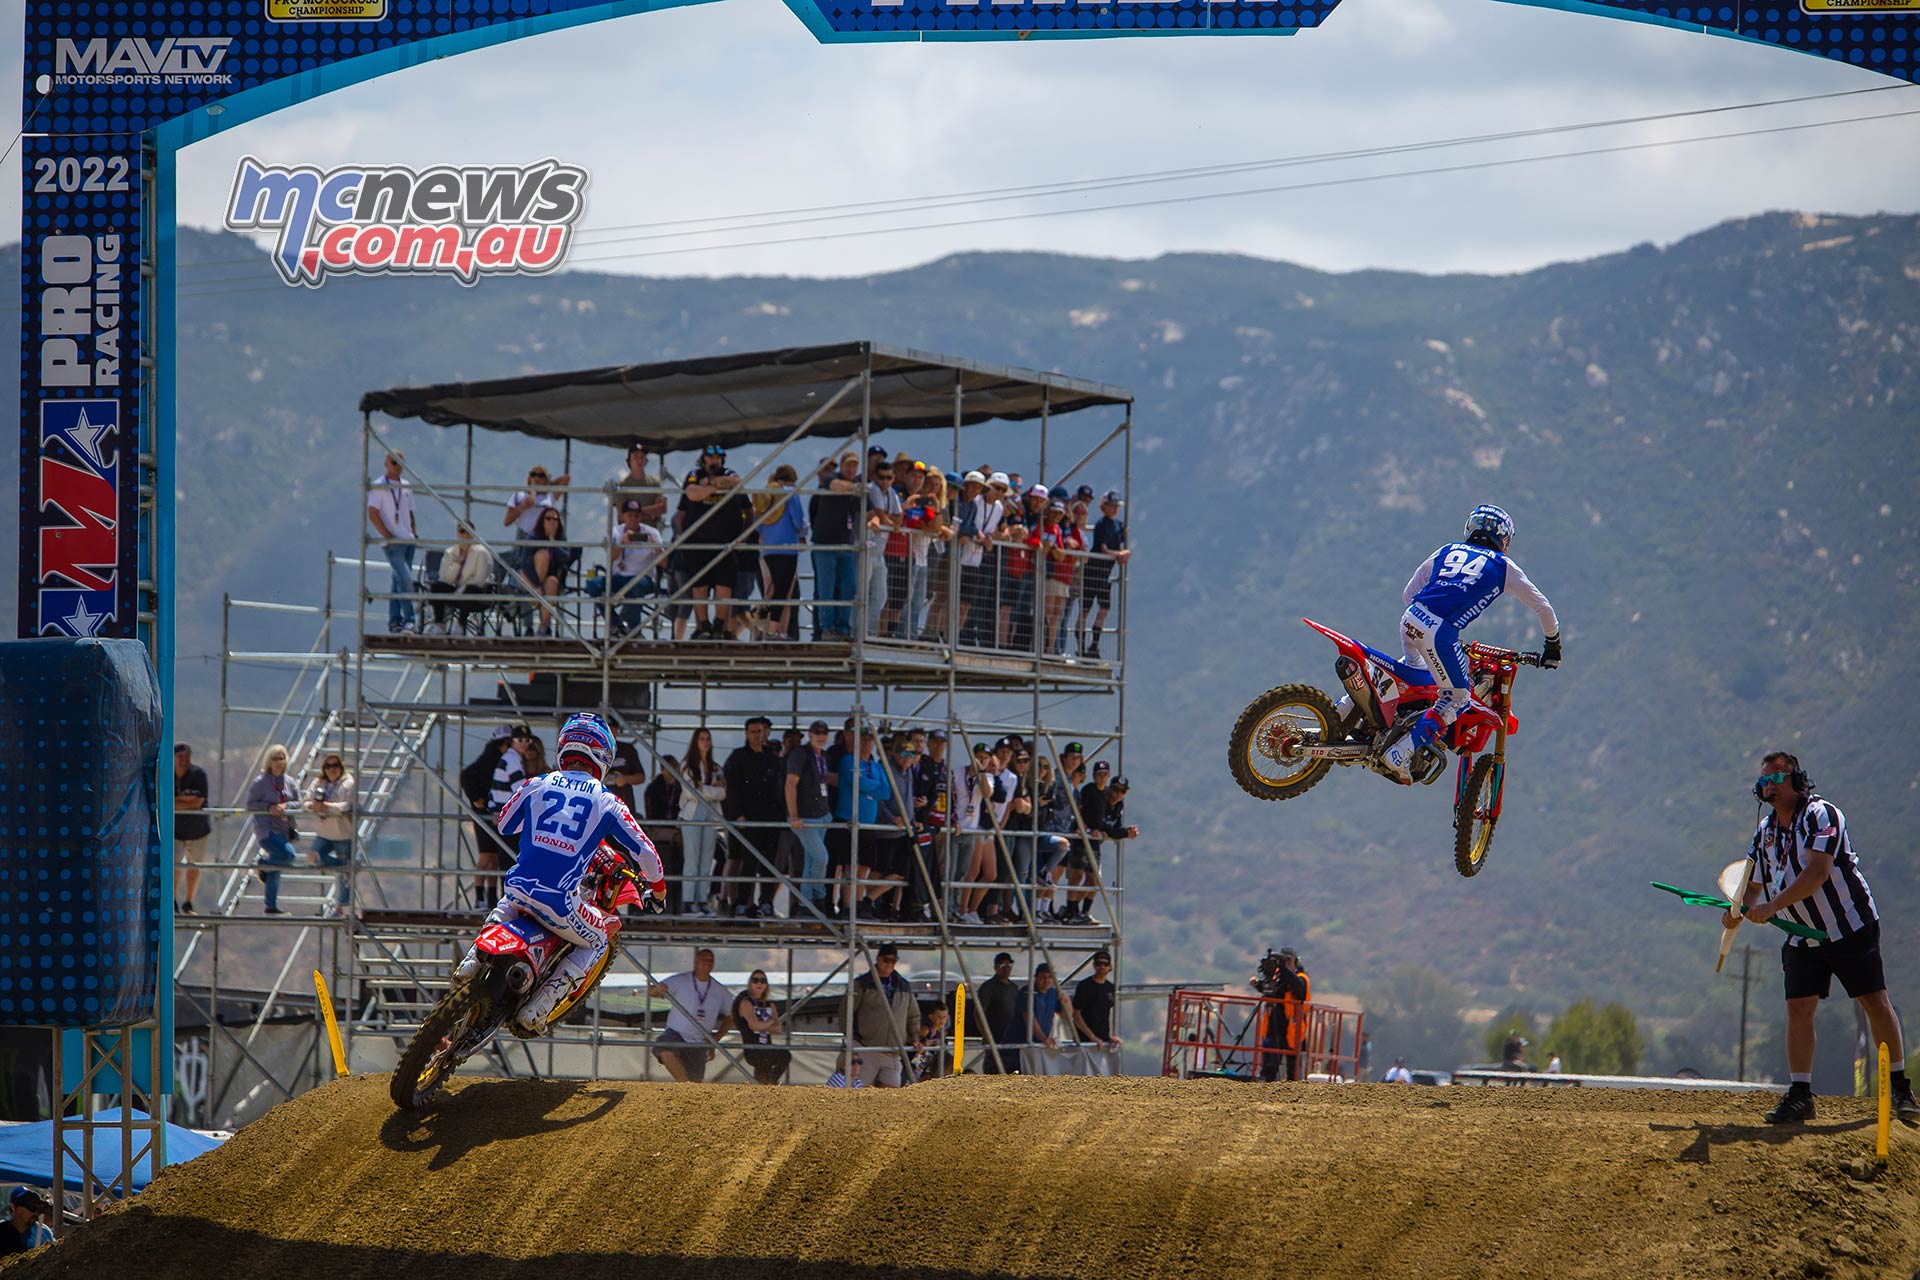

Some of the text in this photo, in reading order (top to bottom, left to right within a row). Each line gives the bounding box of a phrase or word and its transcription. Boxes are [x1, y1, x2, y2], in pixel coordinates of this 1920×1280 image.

[288, 6, 365, 15] CHAMPIONSHIP
[55, 74, 232, 85] MOTORSPORTS NETWORK
[34, 157, 130, 193] 2022
[41, 234, 92, 387] PRO
[96, 234, 120, 387] RACING
[1438, 549, 1488, 585] 94
[1369, 653, 1396, 672] HONDA
[1427, 648, 1447, 681] HONDA
[551, 775, 596, 794] SEXTON
[536, 790, 593, 841] 23
[534, 835, 576, 853] HONDA
